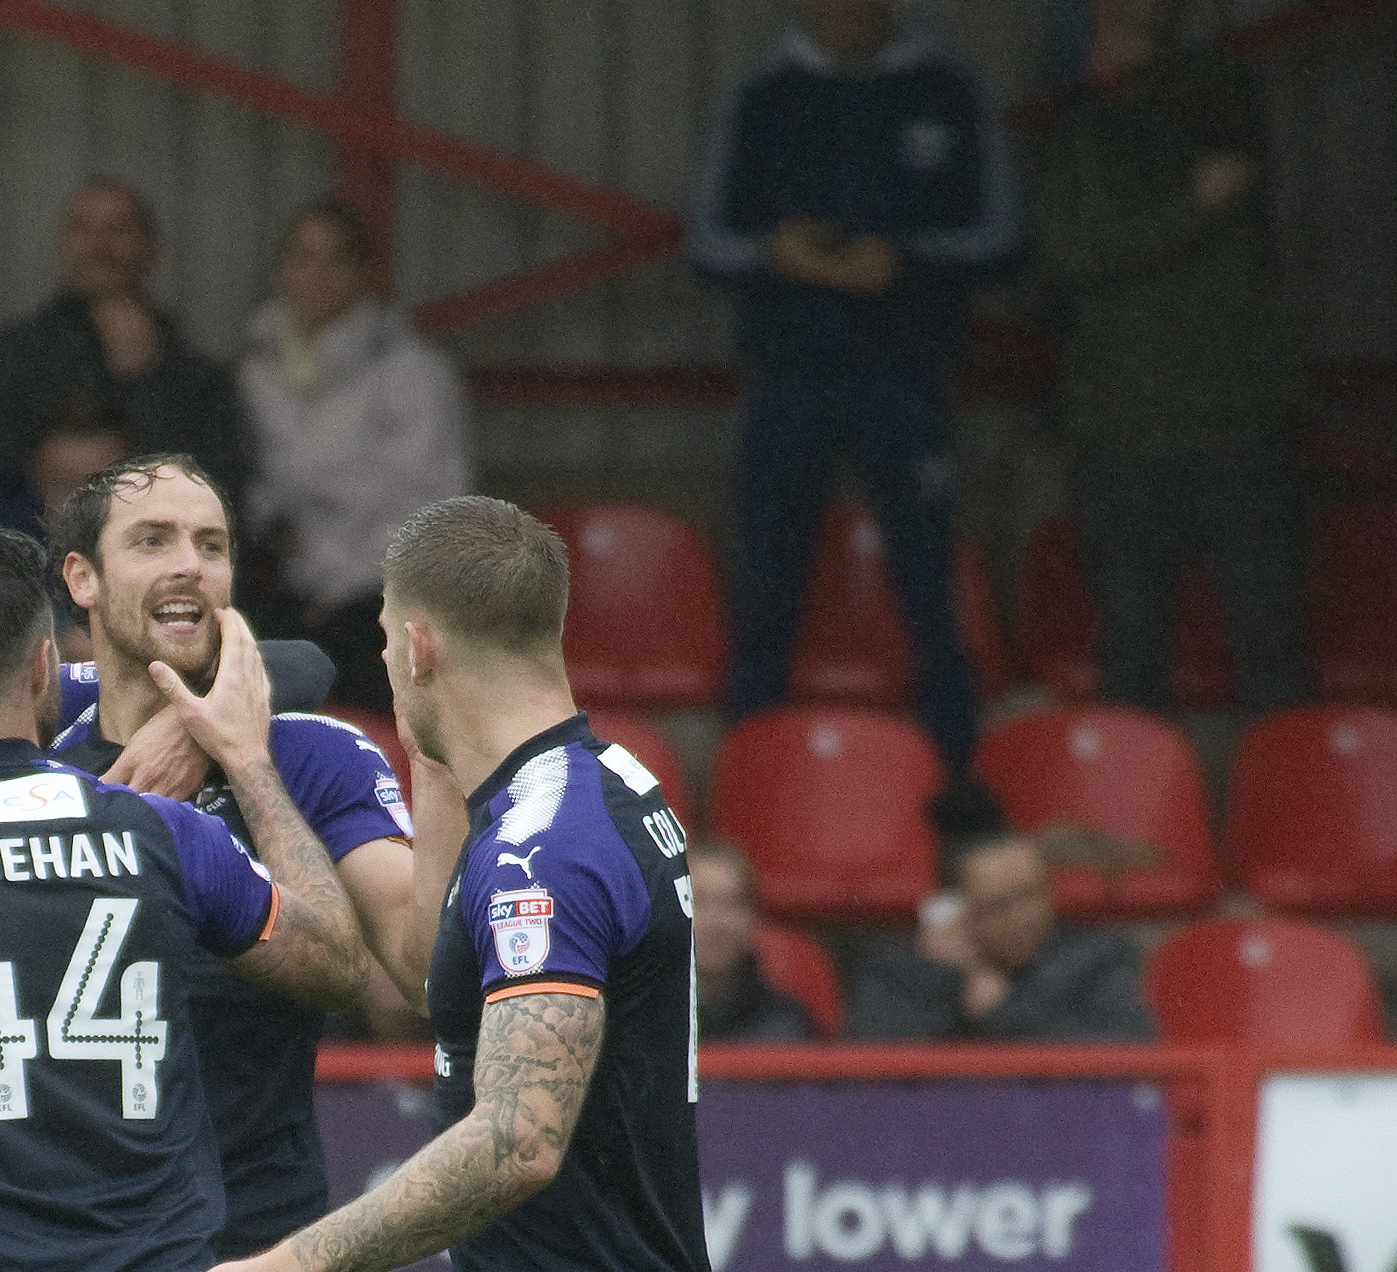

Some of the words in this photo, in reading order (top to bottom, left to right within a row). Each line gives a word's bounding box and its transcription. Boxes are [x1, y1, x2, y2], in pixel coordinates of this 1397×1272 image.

[519, 901, 549, 915] BET
[525, 918, 542, 926] TWO
[512, 955, 530, 966] EFL
[133, 1103, 146, 1112] EFL
[784, 1162, 1091, 1261] lower
